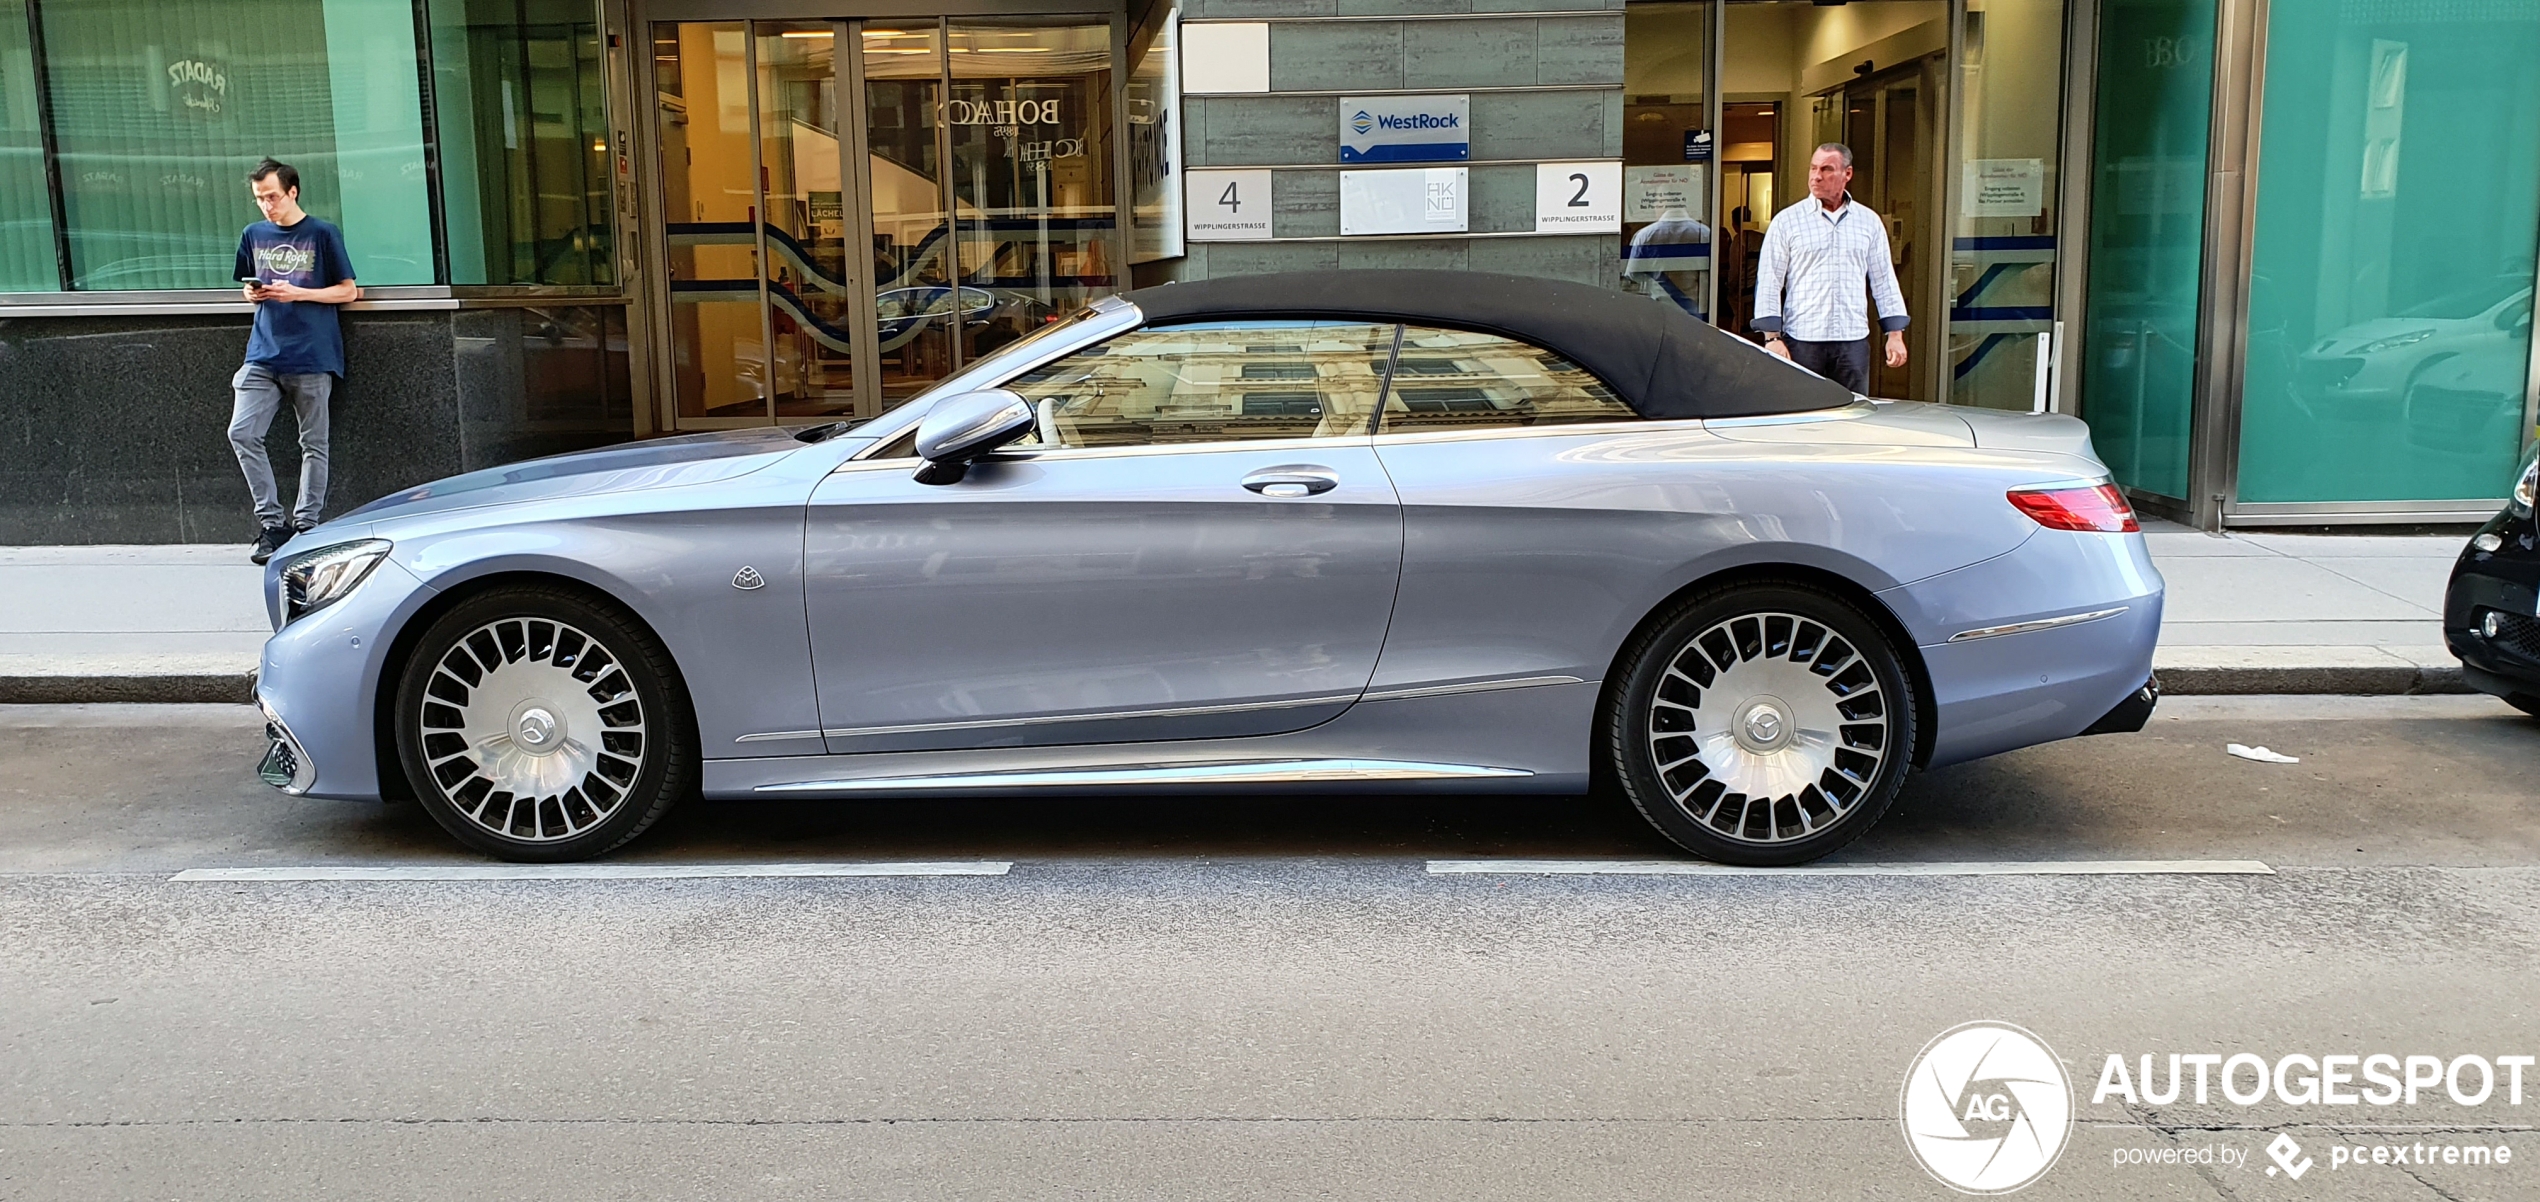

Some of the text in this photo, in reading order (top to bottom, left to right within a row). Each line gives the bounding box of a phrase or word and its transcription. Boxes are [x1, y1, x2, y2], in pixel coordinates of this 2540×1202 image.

[1378, 113, 1459, 129] WestRock
[1219, 181, 1241, 214] 4
[1567, 173, 1590, 207] 2
[1541, 215, 1615, 223] WIPPLINGERSTRASSE
[259, 249, 309, 264] Hard Rock
